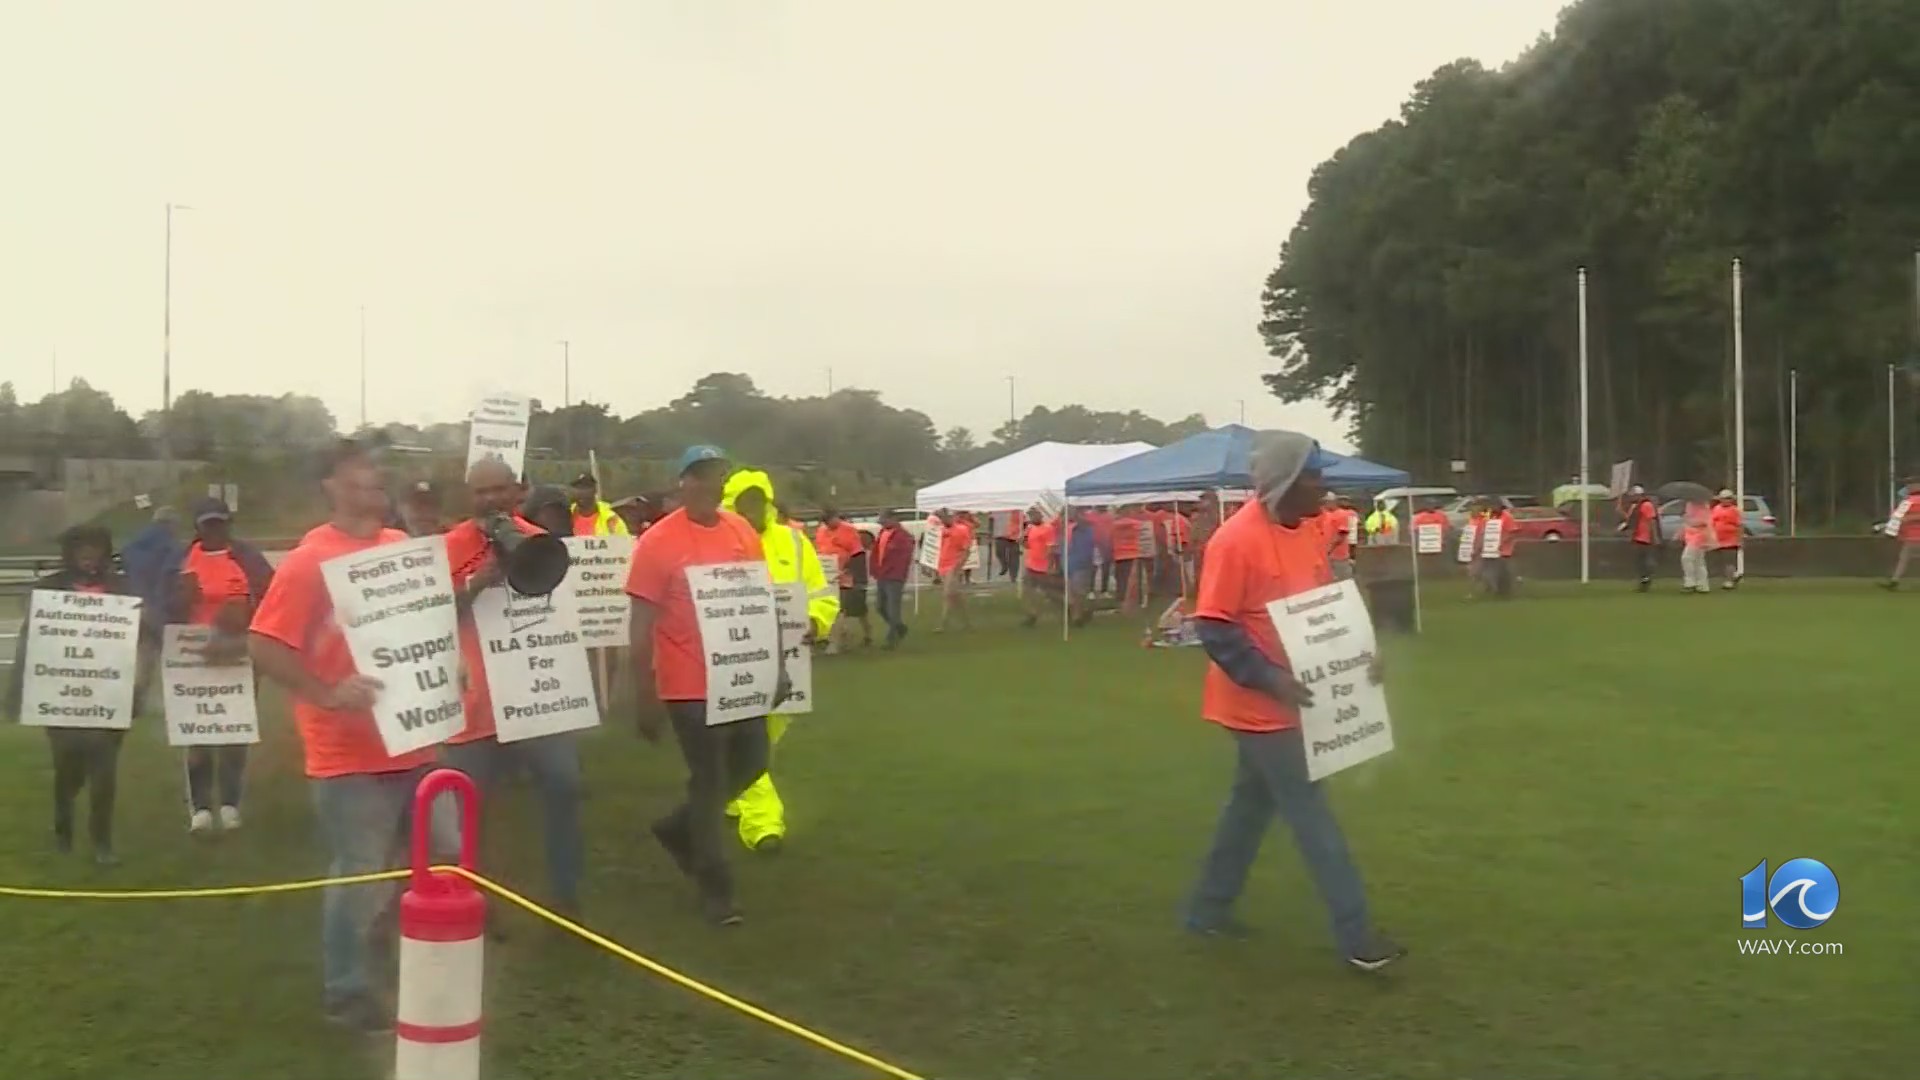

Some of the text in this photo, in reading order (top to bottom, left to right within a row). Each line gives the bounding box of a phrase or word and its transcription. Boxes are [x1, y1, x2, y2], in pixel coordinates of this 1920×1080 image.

[584, 540, 608, 549] ILA
[347, 553, 435, 584] Profit Over
[582, 571, 615, 581] Over
[361, 574, 437, 602] People is
[575, 587, 625, 597] achine
[63, 595, 104, 607] Fight
[35, 609, 133, 626] Automation,
[704, 606, 735, 619] Save
[39, 626, 127, 640] Save Jobs:
[728, 627, 753, 642] ILA
[489, 630, 579, 653] ILA Stands
[63, 646, 95, 659] ILA
[371, 632, 455, 669] Support
[712, 649, 770, 666] Demands
[528, 656, 555, 670] For
[1301, 650, 1374, 684] ILA Stands
[34, 664, 121, 680] Demands
[414, 665, 449, 692] ILA
[730, 672, 754, 688] Job
[59, 684, 94, 698] Job
[173, 683, 244, 698] Support
[530, 677, 561, 694] Job
[1331, 683, 1355, 699] For
[503, 696, 589, 720] Protection
[717, 691, 769, 710] Security
[38, 703, 117, 720] Security
[195, 703, 227, 715] ILA
[1334, 705, 1360, 724] Job
[178, 722, 254, 735] Workers
[1312, 720, 1385, 757] Protection
